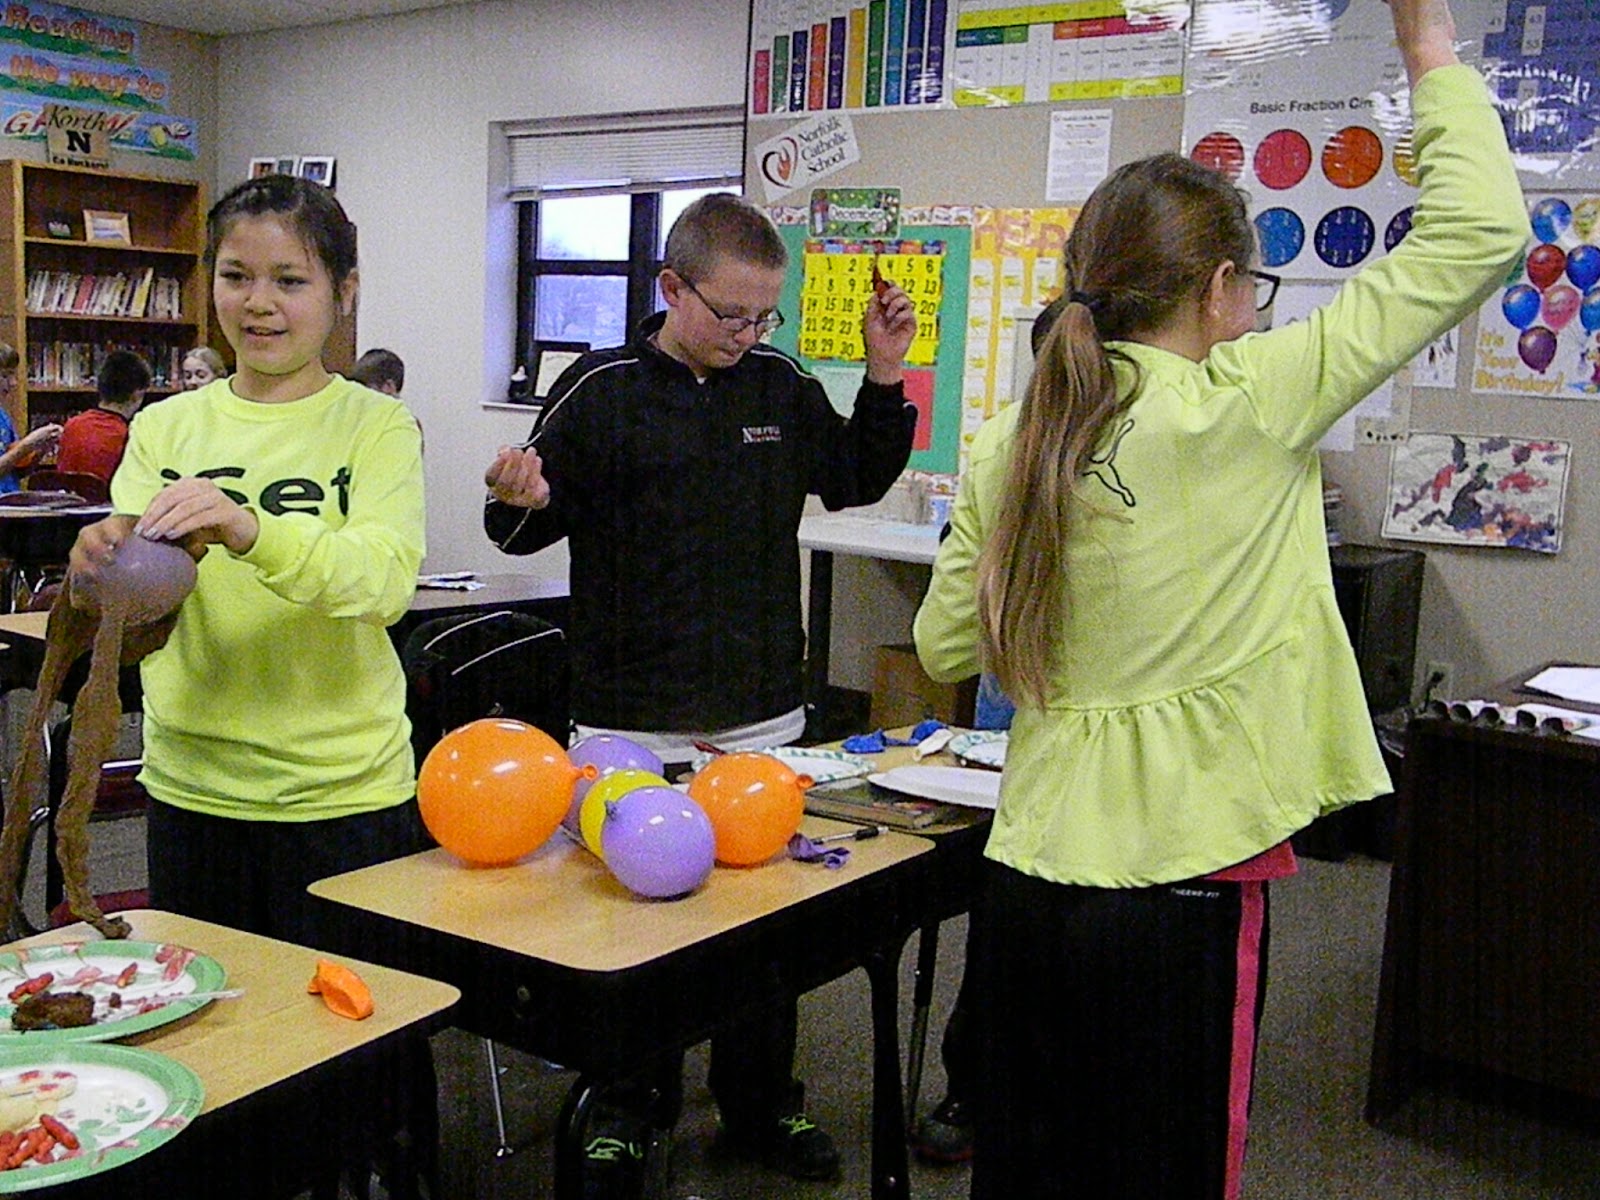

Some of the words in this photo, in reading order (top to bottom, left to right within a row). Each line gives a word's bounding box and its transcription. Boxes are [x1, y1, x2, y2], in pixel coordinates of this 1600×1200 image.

[6, 4, 134, 53] Reading
[10, 55, 60, 83] the
[70, 70, 129, 97] way
[137, 74, 166, 100] to
[1250, 100, 1286, 114] Basic
[1290, 97, 1345, 112] Fraction
[797, 115, 843, 142] Norfolk
[66, 129, 91, 154] N
[800, 131, 849, 161] Catholic
[806, 148, 847, 175] School
[830, 206, 884, 221] December
[826, 257, 833, 270] 1
[848, 258, 857, 272] 2
[887, 259, 895, 273] 4
[906, 258, 915, 272] 5
[925, 259, 935, 274] 6
[809, 277, 816, 290] 7
[827, 278, 835, 291] 8
[848, 278, 857, 292] 9
[924, 279, 938, 295] 13
[806, 298, 817, 312] 14
[824, 297, 837, 311] 15
[841, 298, 855, 312] 16
[919, 301, 936, 316] 20
[805, 317, 817, 333] 21
[821, 316, 835, 332] 22
[838, 321, 853, 335] 23
[919, 323, 933, 337] 27
[804, 338, 818, 353] 28
[821, 338, 834, 353] 29
[839, 344, 855, 357] 30
